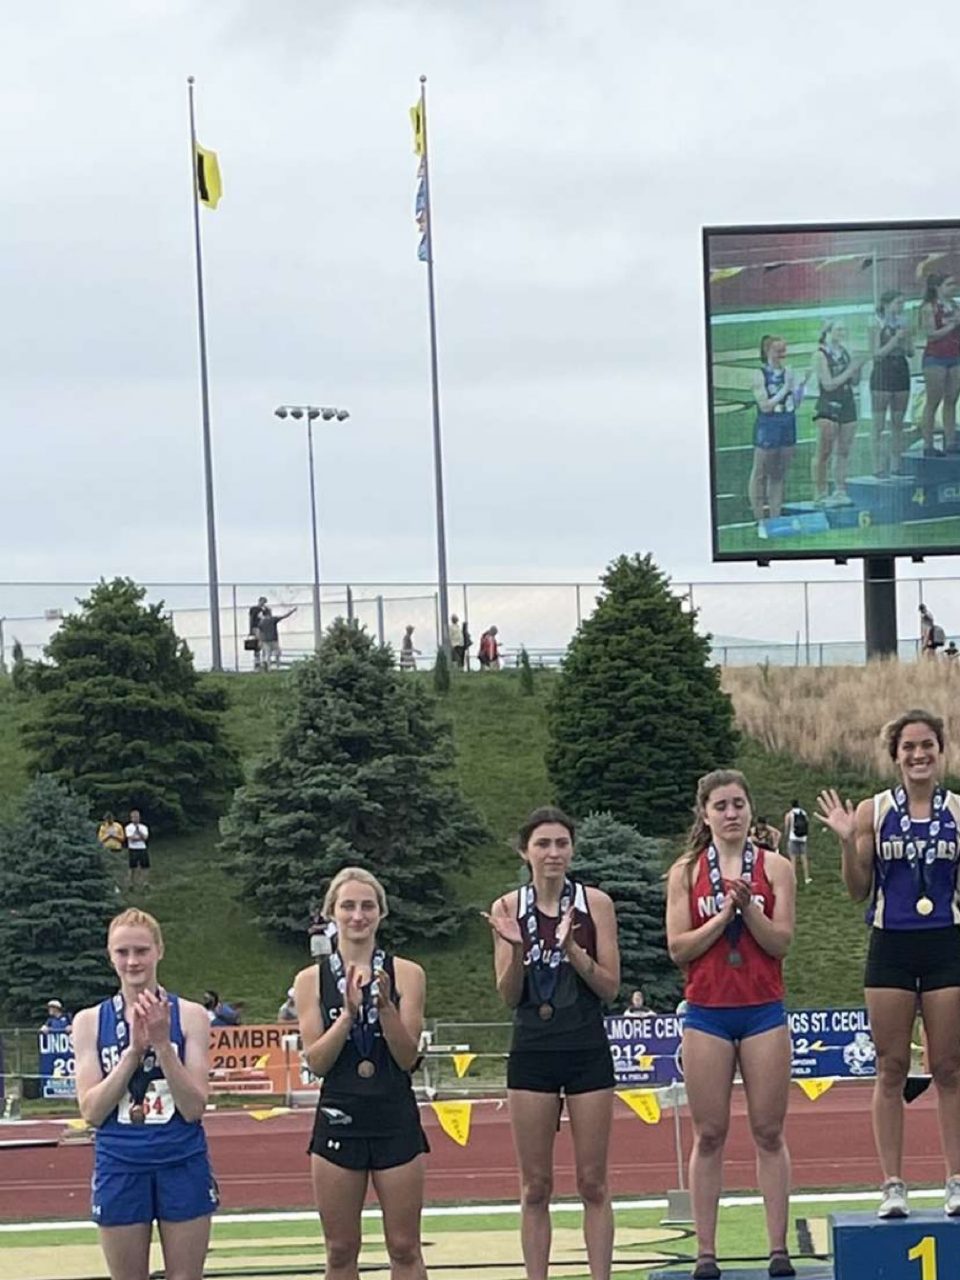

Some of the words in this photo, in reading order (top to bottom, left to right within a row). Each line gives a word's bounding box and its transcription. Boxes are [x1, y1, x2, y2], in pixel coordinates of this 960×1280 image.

[911, 487, 925, 505] 4
[858, 510, 872, 528] 6
[787, 1012, 810, 1034] GS
[811, 1012, 830, 1033] ST.
[208, 1029, 303, 1050] AMBR
